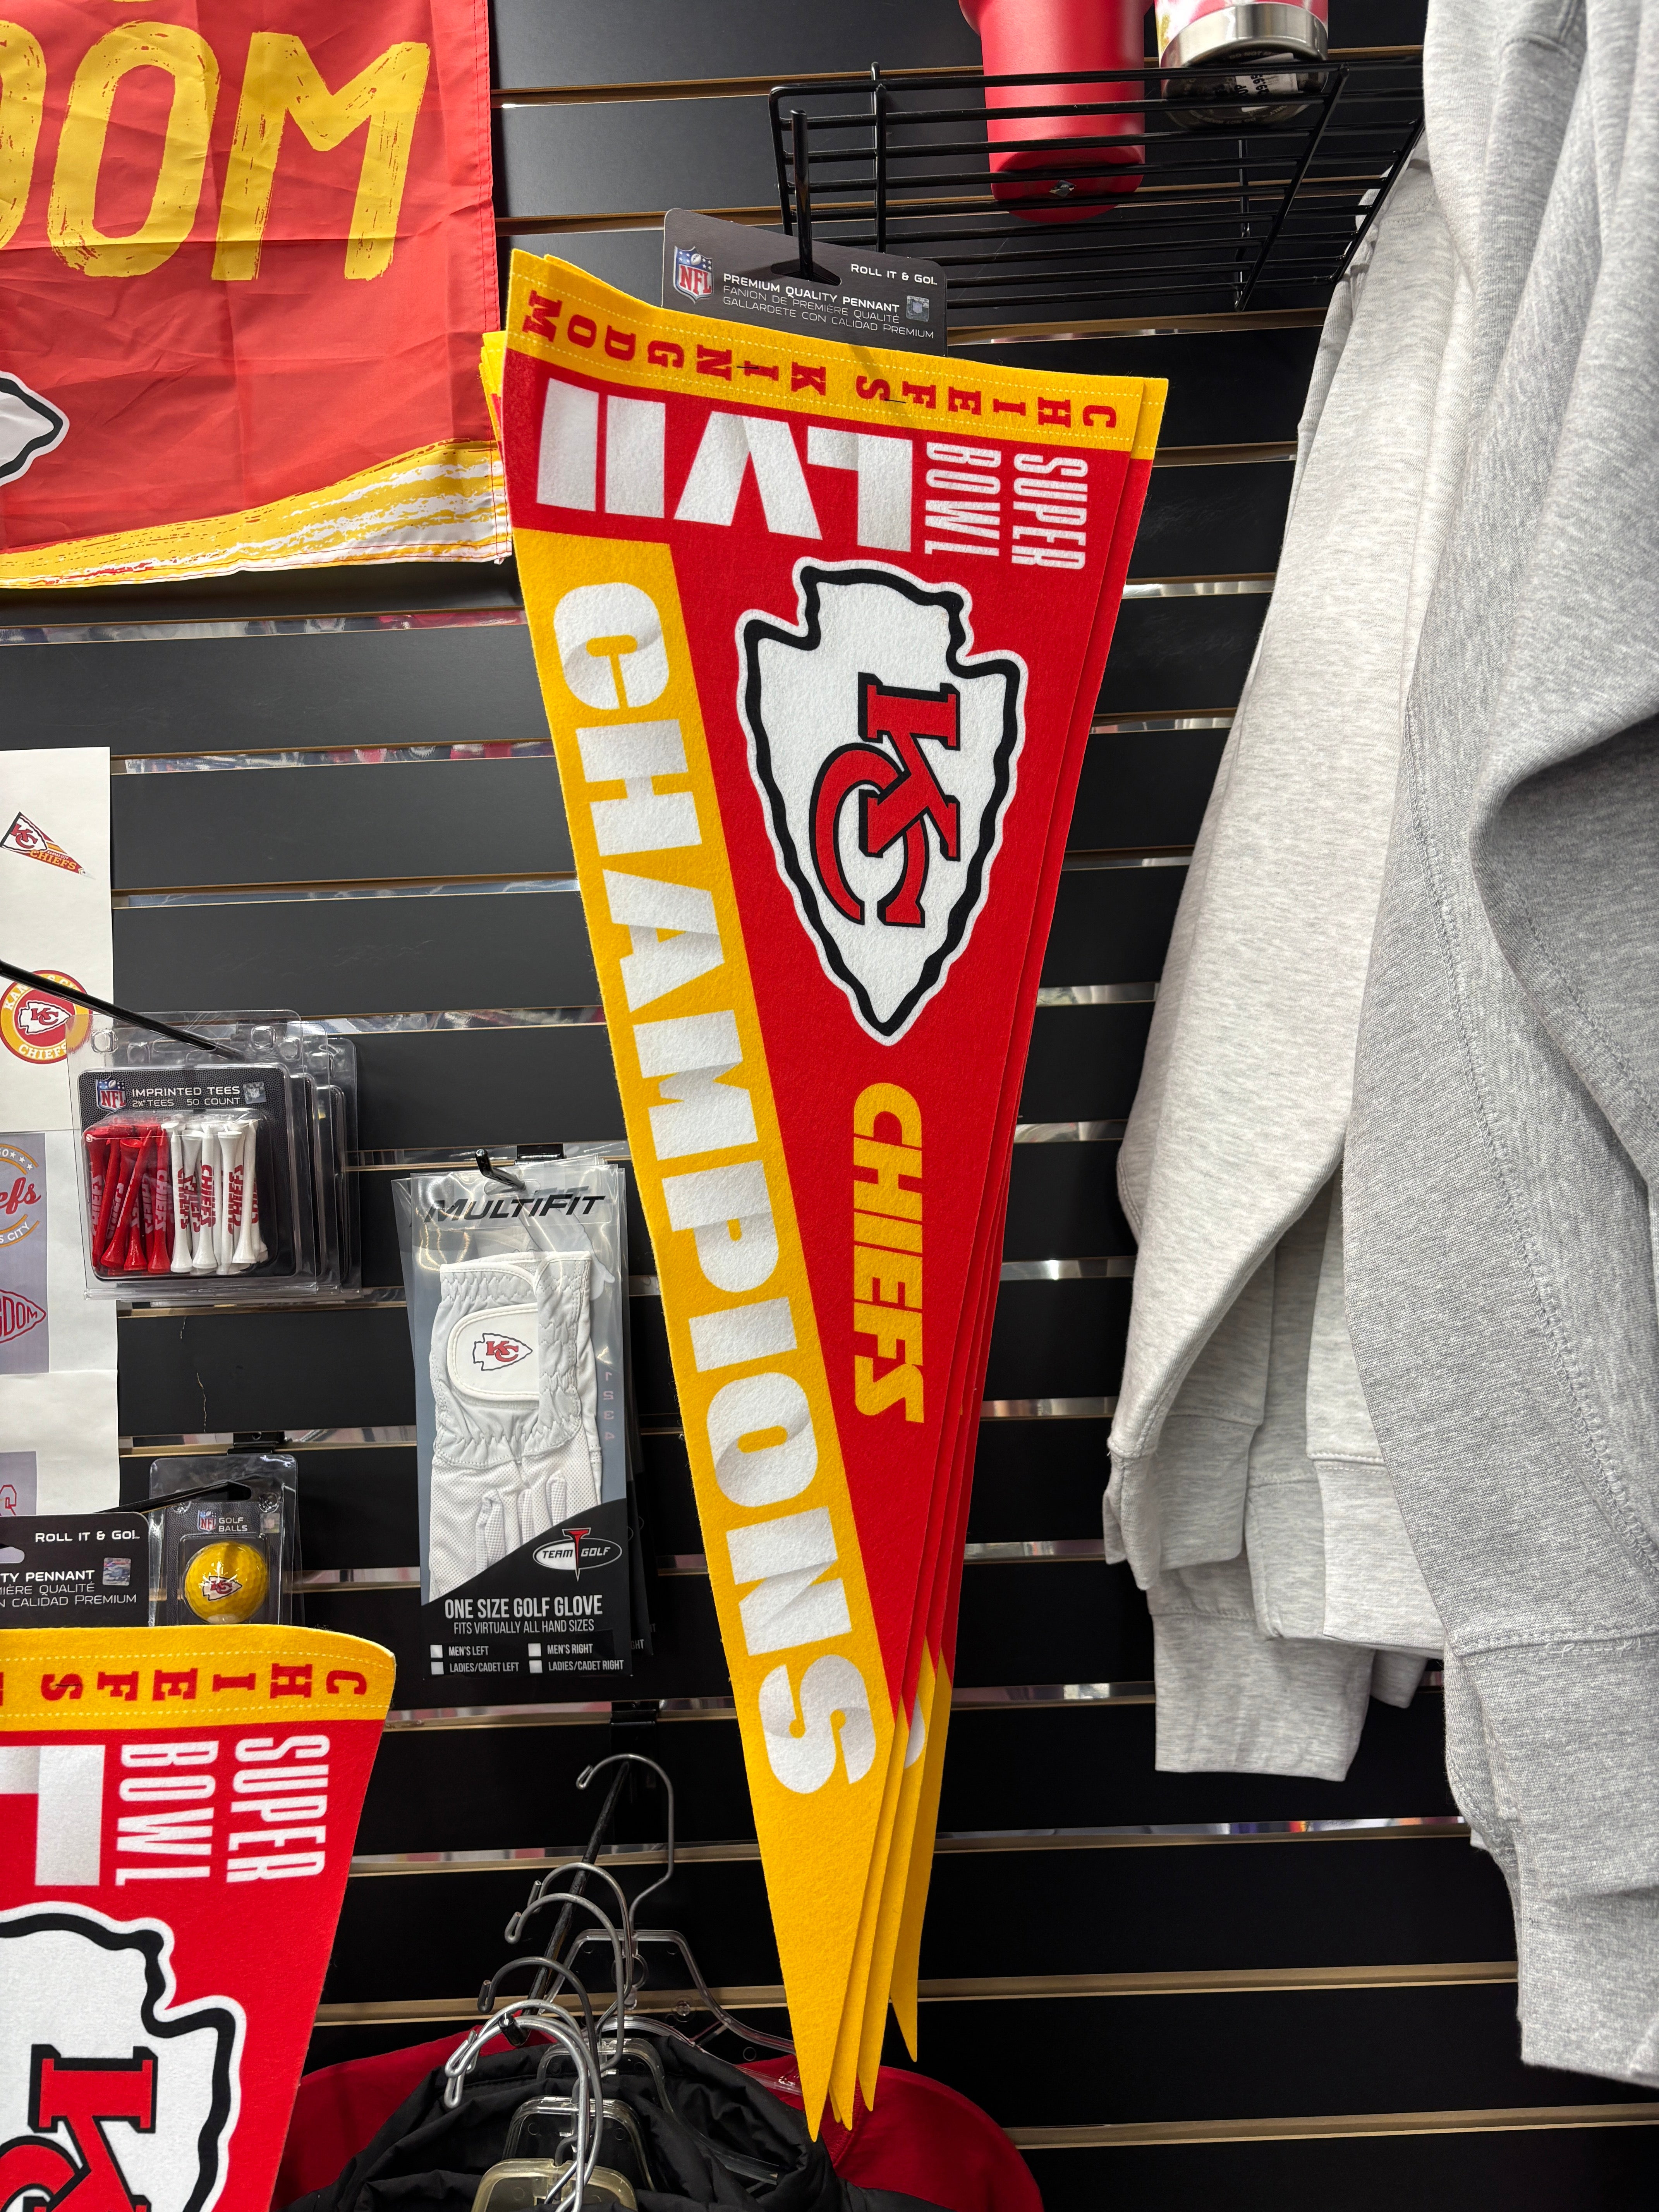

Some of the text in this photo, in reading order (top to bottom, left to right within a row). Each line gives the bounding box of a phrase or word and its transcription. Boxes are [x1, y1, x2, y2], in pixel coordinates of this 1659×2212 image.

[1235, 84, 1250, 96] UP
[0, 21, 429, 280] OM
[679, 265, 712, 294] NFL
[851, 263, 882, 277] ROLL
[886, 270, 896, 280] IT
[902, 272, 909, 281] &
[723, 273, 900, 313] PREMIUM QUALITY PENNANT
[723, 285, 900, 324] FANION DE PREMIÈRE QUALITÉ
[723, 296, 934, 339] GALLARDETE CON CALIDAD PREMIUM
[522, 290, 1116, 428] CHIEFS KINGDOM
[538, 379, 913, 552] LVII
[925, 442, 1001, 556] BOWL
[1012, 454, 1088, 569] SUPER
[30, 849, 77, 870] CHIEFS
[100, 1091, 126, 1108] NFL
[132, 1086, 240, 1097] IMPRINTED TEES
[204, 1097, 241, 1106] COUNT
[0, 1177, 41, 1214] efs
[201, 1165, 213, 1227] CHIEFS
[552, 581, 877, 1794] CHAMPIONS
[156, 1170, 167, 1231] CHIEFS
[7, 1222, 30, 1241] CITY
[854, 1084, 924, 1423] CHIEFS
[0, 1296, 38, 1336] DOM
[35, 1532, 73, 1542] ROLL
[79, 1532, 91, 1541] IT
[96, 1530, 105, 1540] &
[543, 1547, 611, 1559] TEAM GOLF
[26, 1570, 95, 1582] PENNANT
[12, 1596, 68, 1607] CALIDAD
[75, 1594, 137, 1605] PREMIUM
[40, 1582, 95, 1596] QUALITÉ
[445, 1595, 603, 1619] ONE SIZE GOLF GLOVE
[453, 1619, 594, 1635] FITS VIRTUALLY ALL HAND SIZES
[448, 1645, 489, 1656] MEN'S LEFT
[547, 1643, 593, 1654] MEN'S RIGHT
[630, 1639, 644, 1650] GHT
[450, 1661, 519, 1673] LADIES/CADET LEFT
[548, 1659, 624, 1671] LADIES/CADET RIGHT
[41, 1664, 366, 1700] CHIEFS
[116, 1741, 219, 1886] BOWL
[227, 1735, 330, 1882] SUPER
